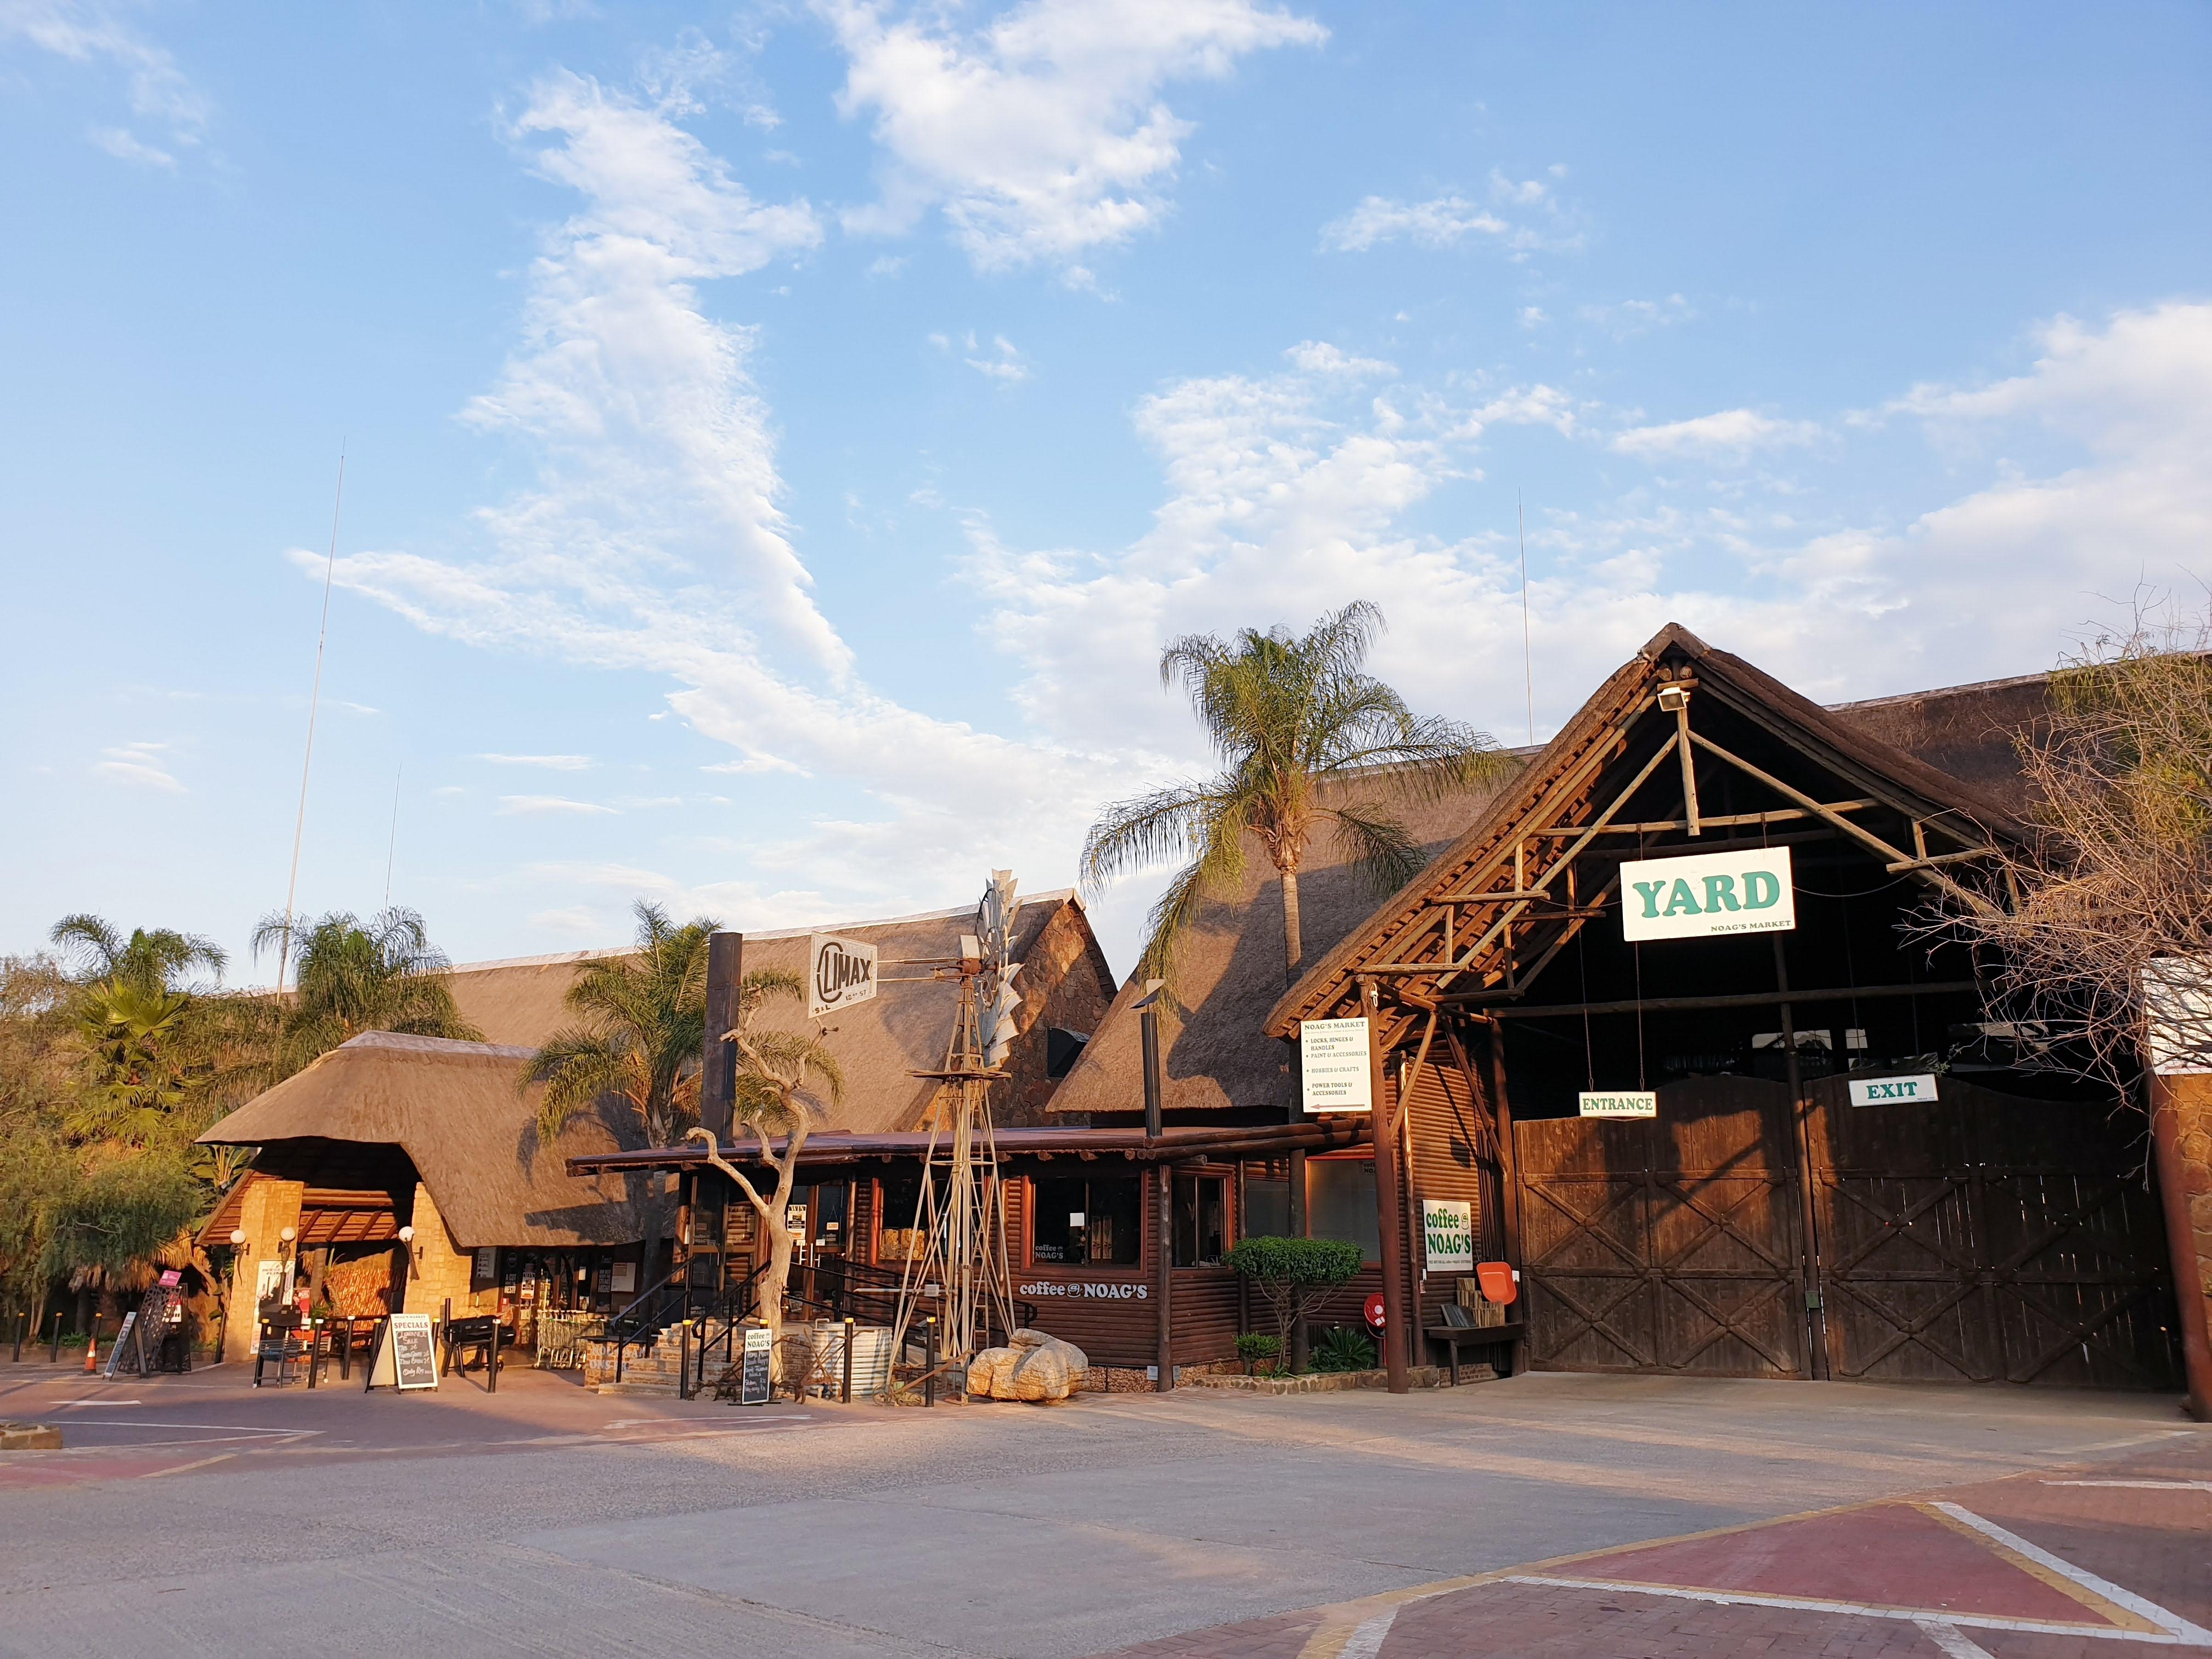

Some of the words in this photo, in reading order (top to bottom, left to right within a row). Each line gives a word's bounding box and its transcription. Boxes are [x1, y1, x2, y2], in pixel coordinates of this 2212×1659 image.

[1632, 871, 1780, 918] YARD
[1750, 920, 1792, 929] MARKET
[817, 942, 871, 1003] CLIMAX
[1866, 1081, 1917, 1099] EXIT
[1582, 1098, 1653, 1110] ENTRANCE
[1426, 1208, 1459, 1229] coffee
[1427, 1233, 1471, 1254] NOAG'S
[1019, 1282, 1065, 1295] coffee
[1084, 1283, 1148, 1299] NOAG'S
